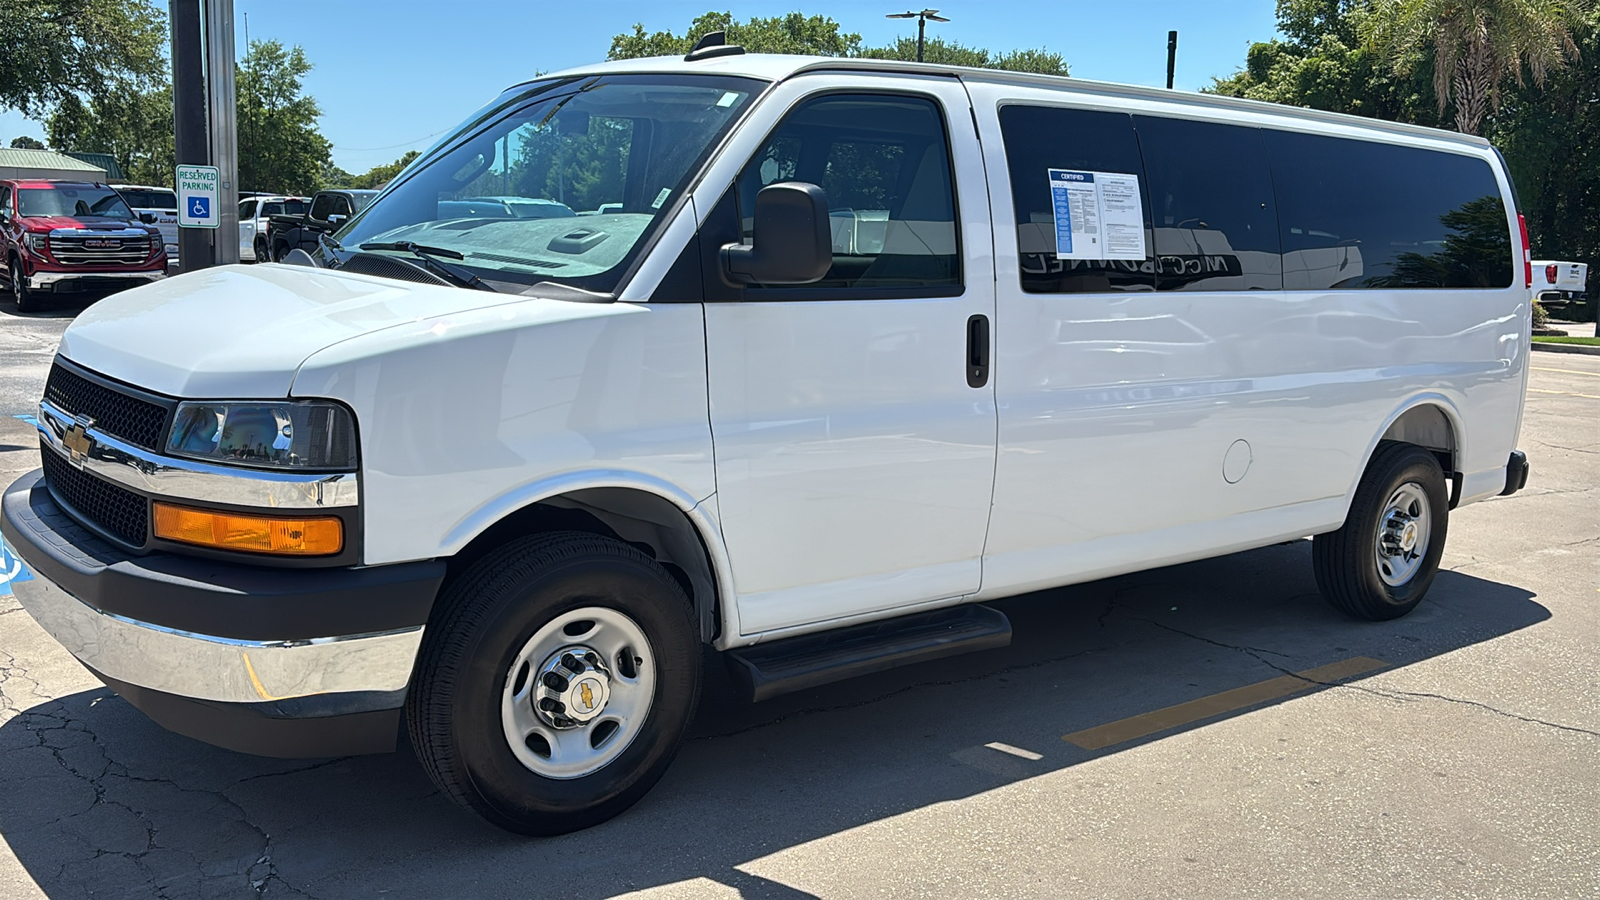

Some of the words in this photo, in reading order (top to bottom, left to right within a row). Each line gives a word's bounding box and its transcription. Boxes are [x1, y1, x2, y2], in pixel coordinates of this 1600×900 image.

[179, 171, 216, 181] RESERVED
[1060, 173, 1085, 181] CERTIFIED
[182, 181, 214, 191] PARKING
[85, 239, 121, 247] GMC
